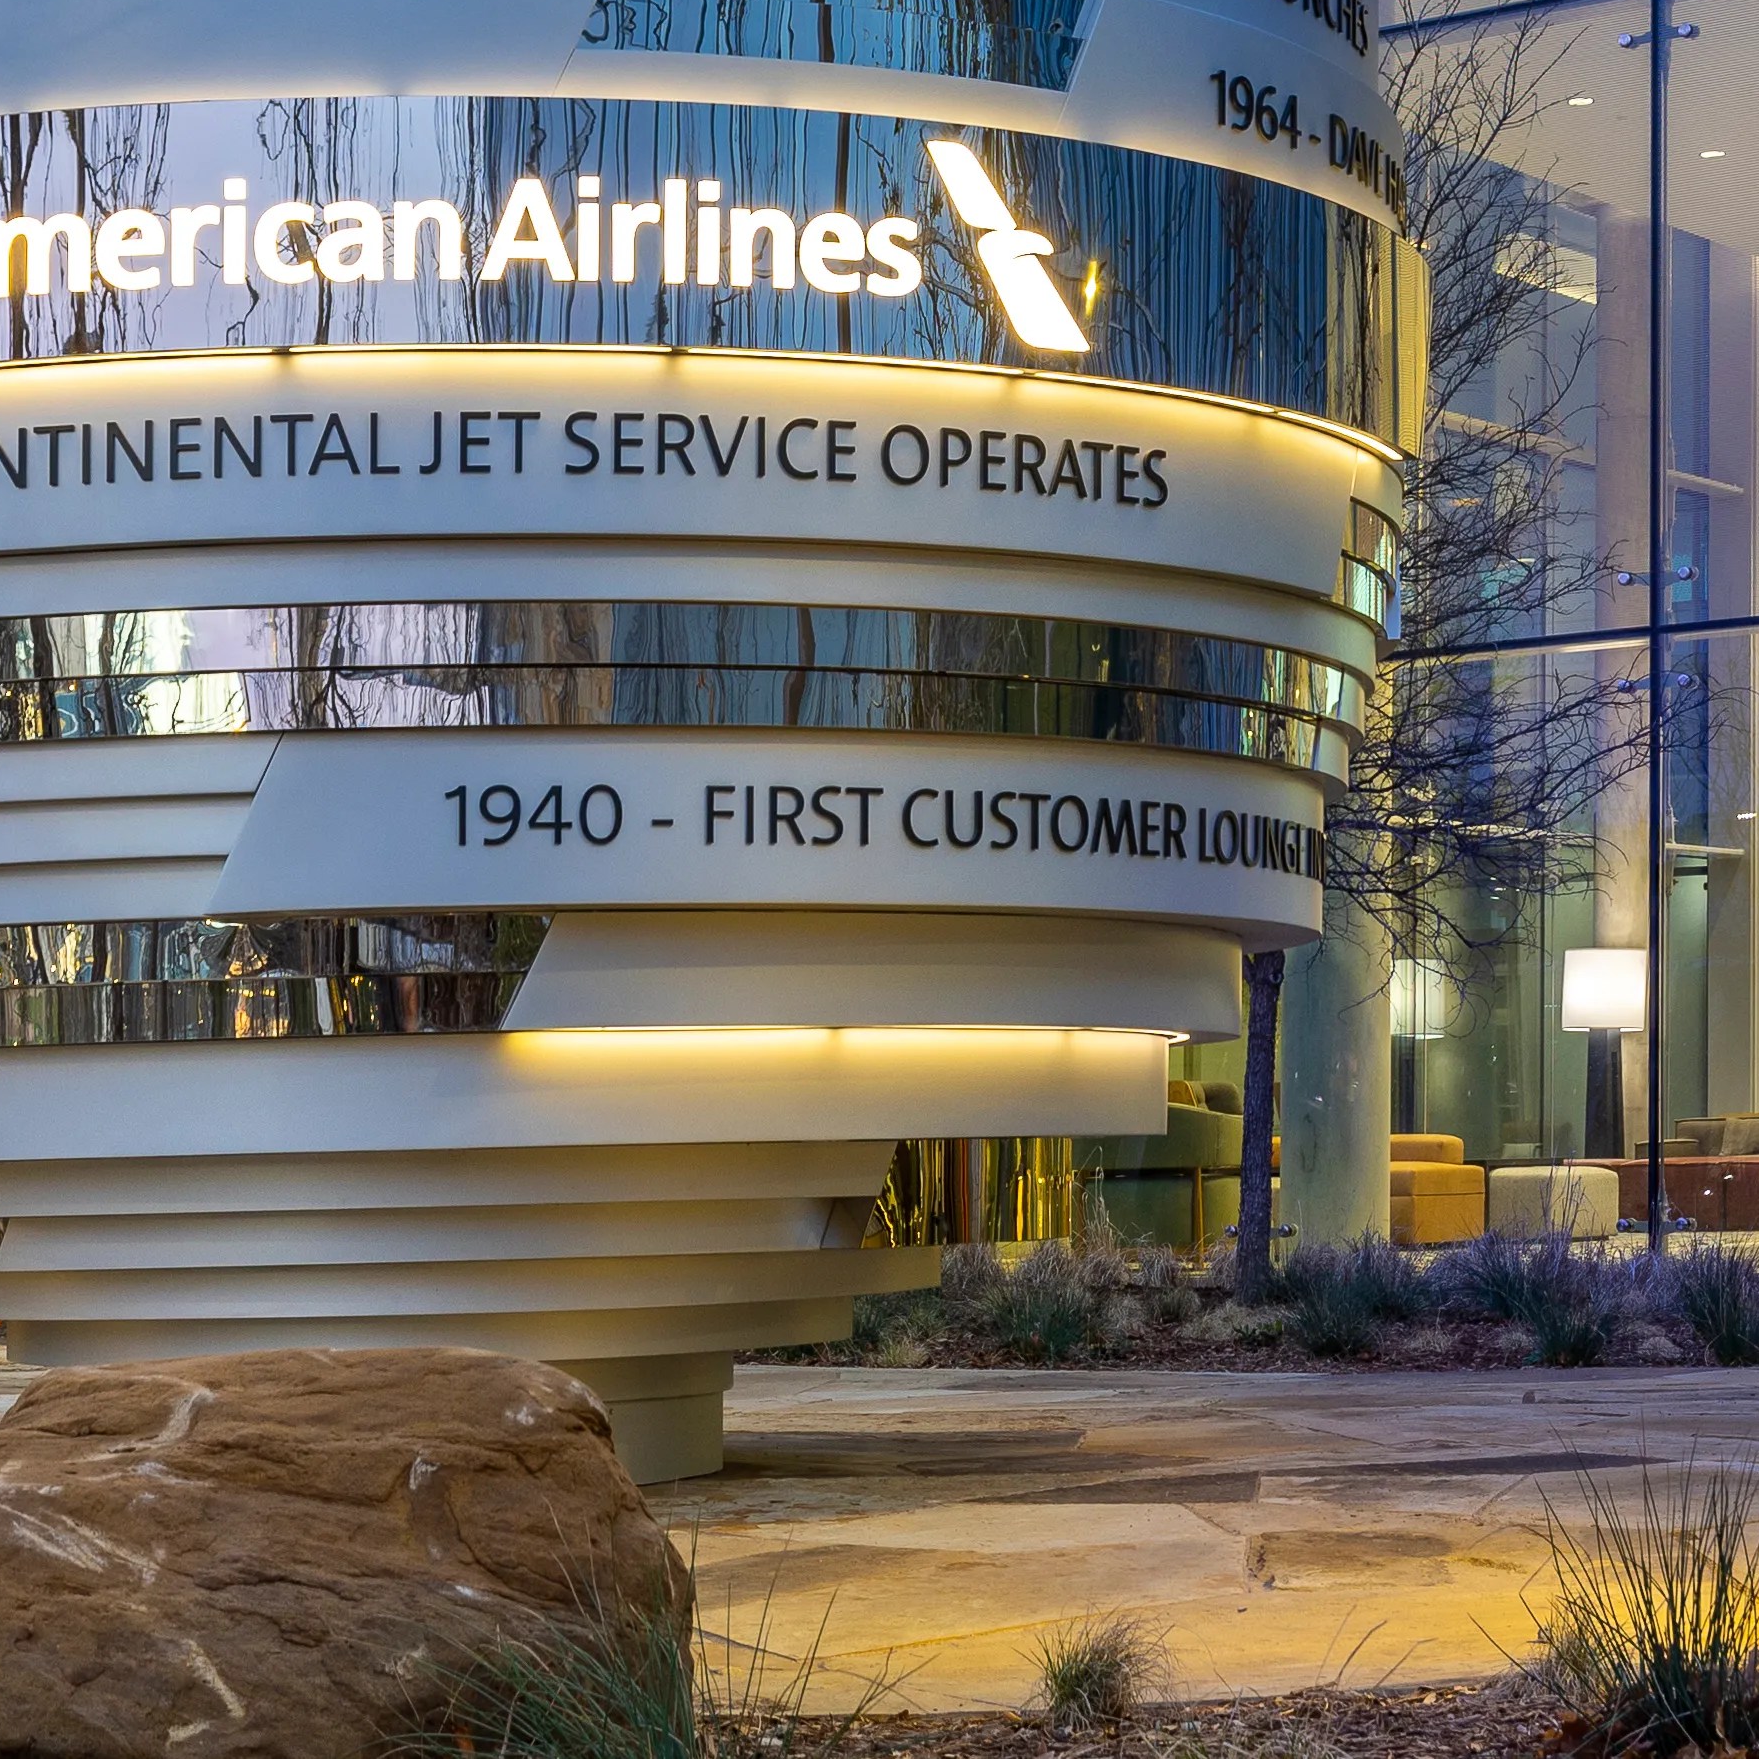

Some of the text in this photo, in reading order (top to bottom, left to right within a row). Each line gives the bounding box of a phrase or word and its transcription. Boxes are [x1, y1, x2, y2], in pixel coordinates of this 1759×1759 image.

[1209, 69, 1303, 150] 1964
[1308, 133, 1322, 145] -
[1328, 113, 1384, 199] DAVE
[479, 176, 922, 298] Airlines
[419, 410, 541, 476] JET
[564, 410, 857, 484] SERVICE
[879, 423, 1169, 510] OPERATES
[444, 783, 623, 847] 1940
[650, 818, 674, 828] -
[704, 784, 885, 848] FIRST
[900, 787, 1188, 861] CUSTOMER
[1198, 807, 1307, 877] LOUNGE
